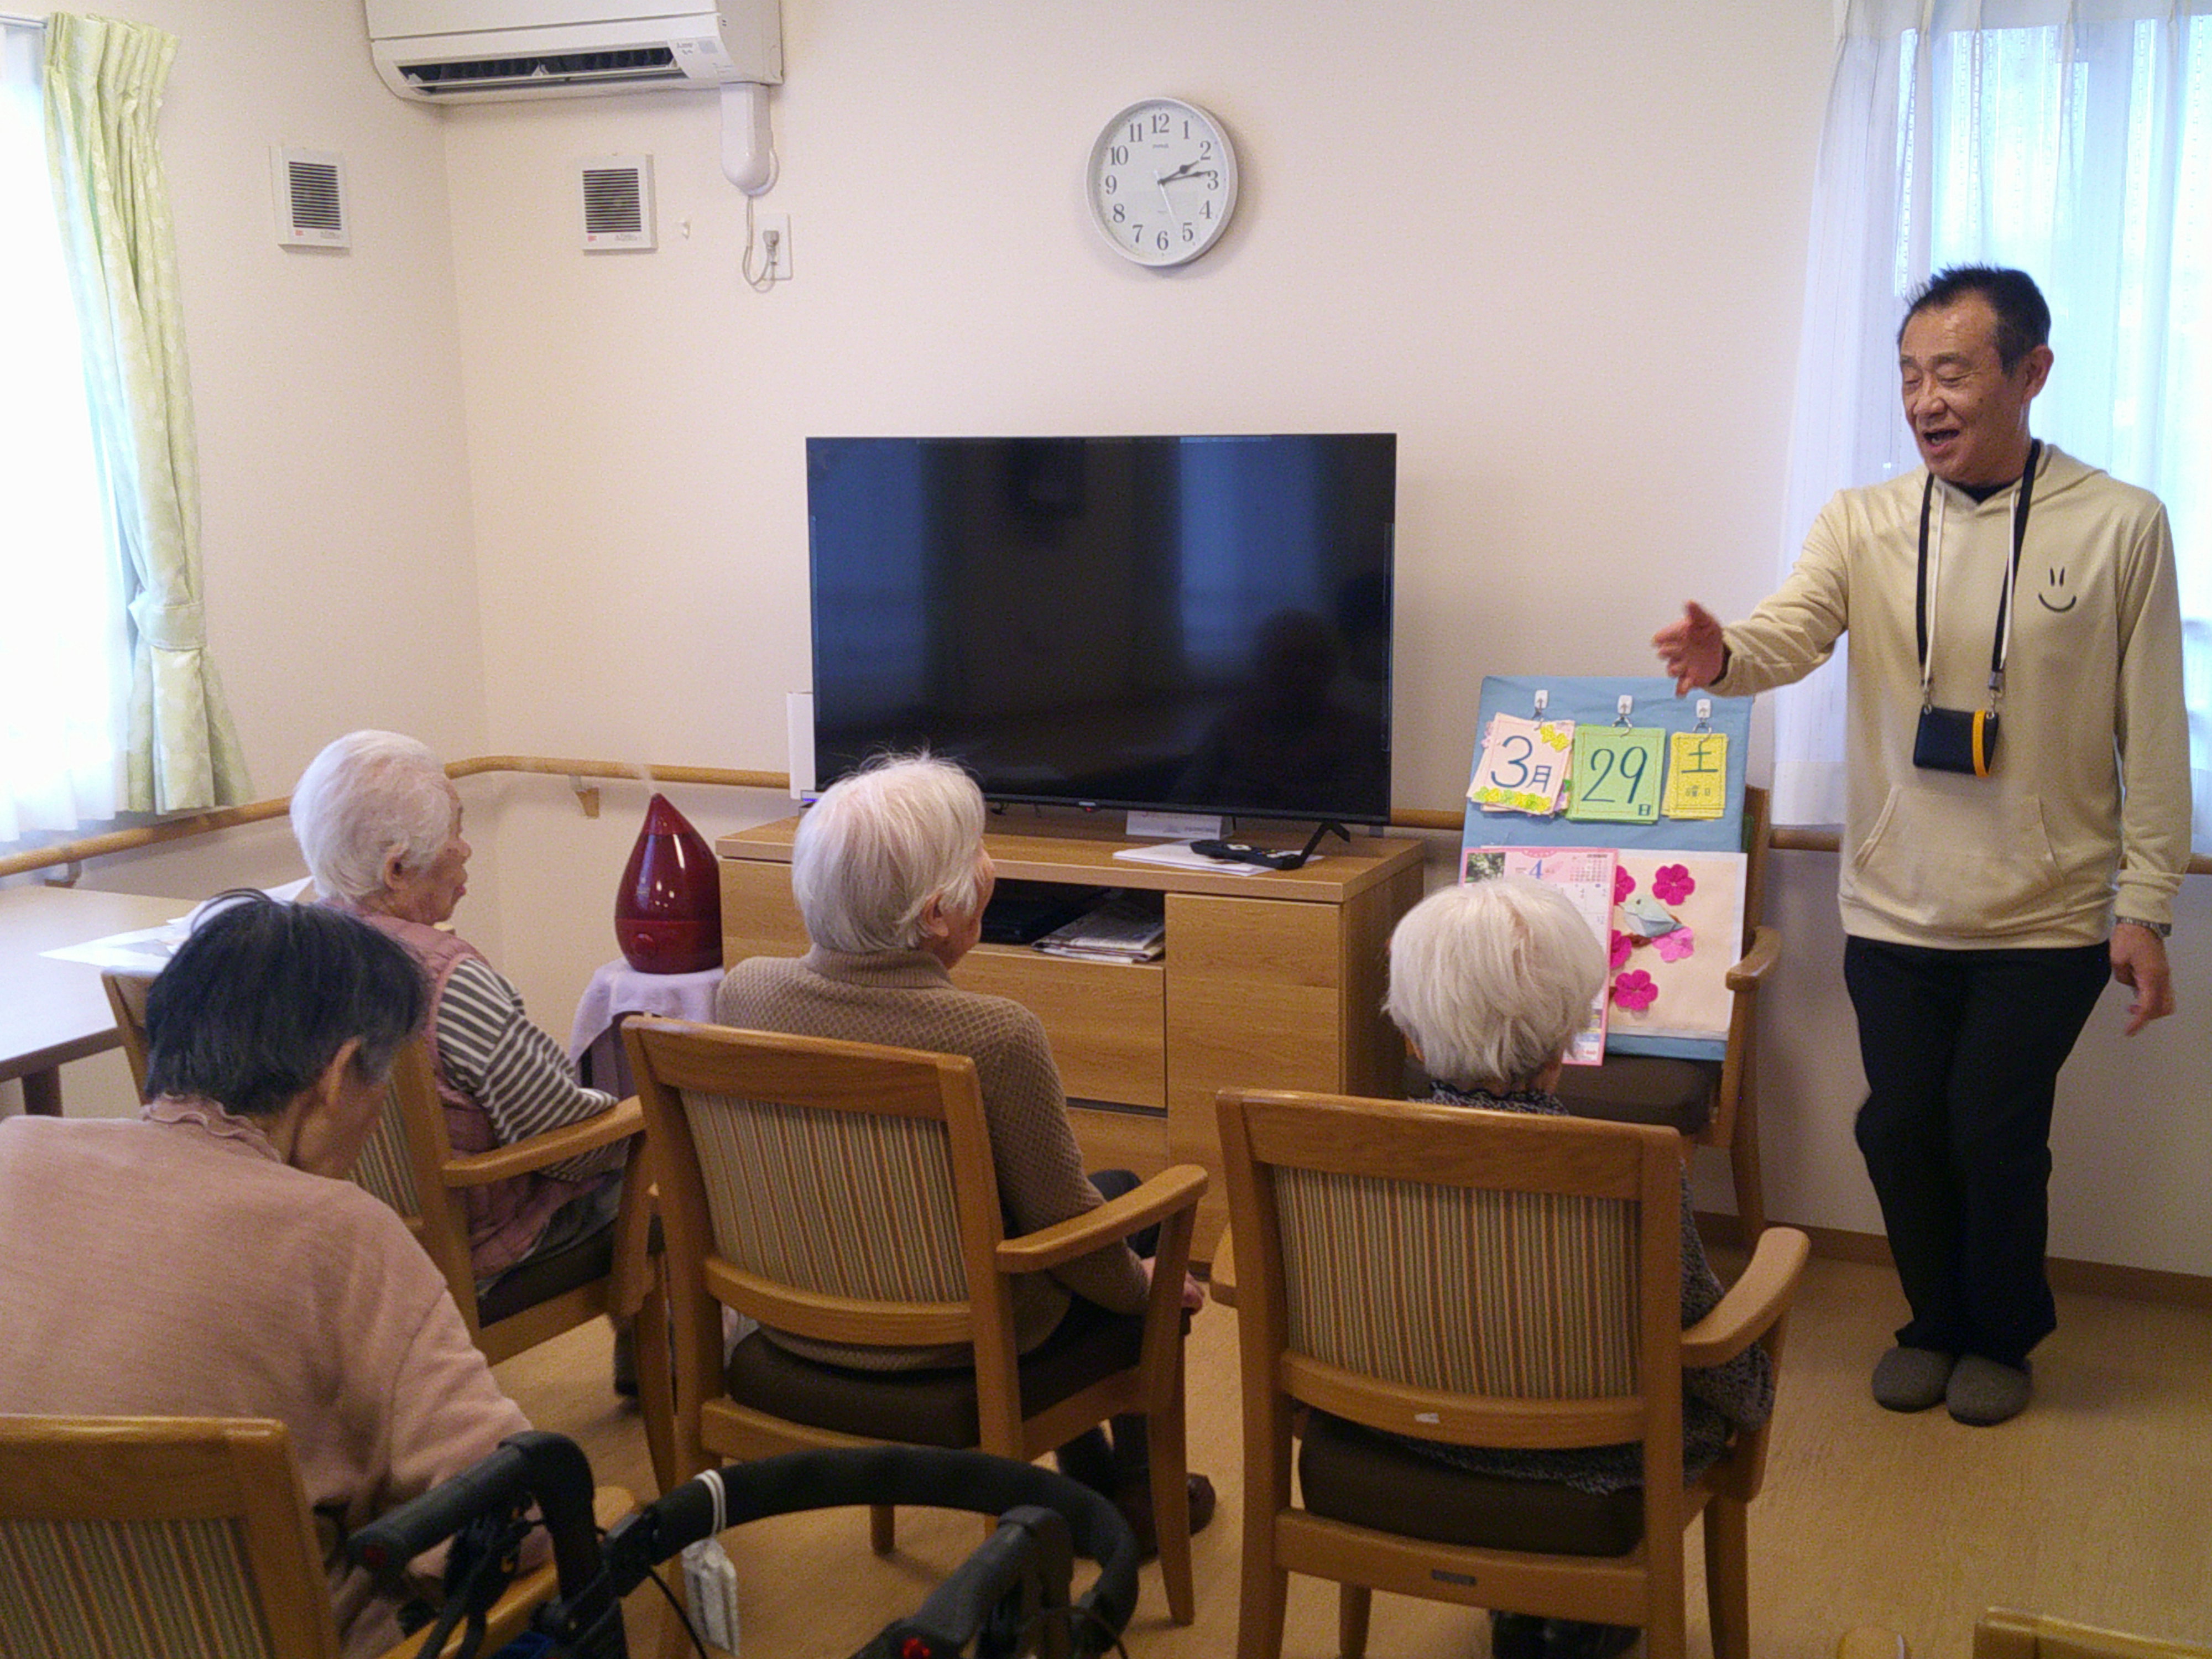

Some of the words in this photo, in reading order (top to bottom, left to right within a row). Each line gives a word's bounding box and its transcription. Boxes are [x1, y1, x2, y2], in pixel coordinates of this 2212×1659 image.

[1129, 123, 1143, 143] 11
[1151, 113, 1170, 134] 12
[1183, 120, 1190, 139] 1
[1110, 145, 1129, 165] 10
[1199, 140, 1211, 160] 2
[1105, 175, 1117, 195] 9
[1207, 170, 1219, 190] 3
[1113, 204, 1125, 223] 8
[1198, 200, 1212, 220] 4
[1133, 224, 1143, 243] 7
[1156, 231, 1168, 251] 6
[1182, 222, 1193, 242] 5
[1681, 742, 1718, 774] 土
[1528, 859, 1543, 880] 4
